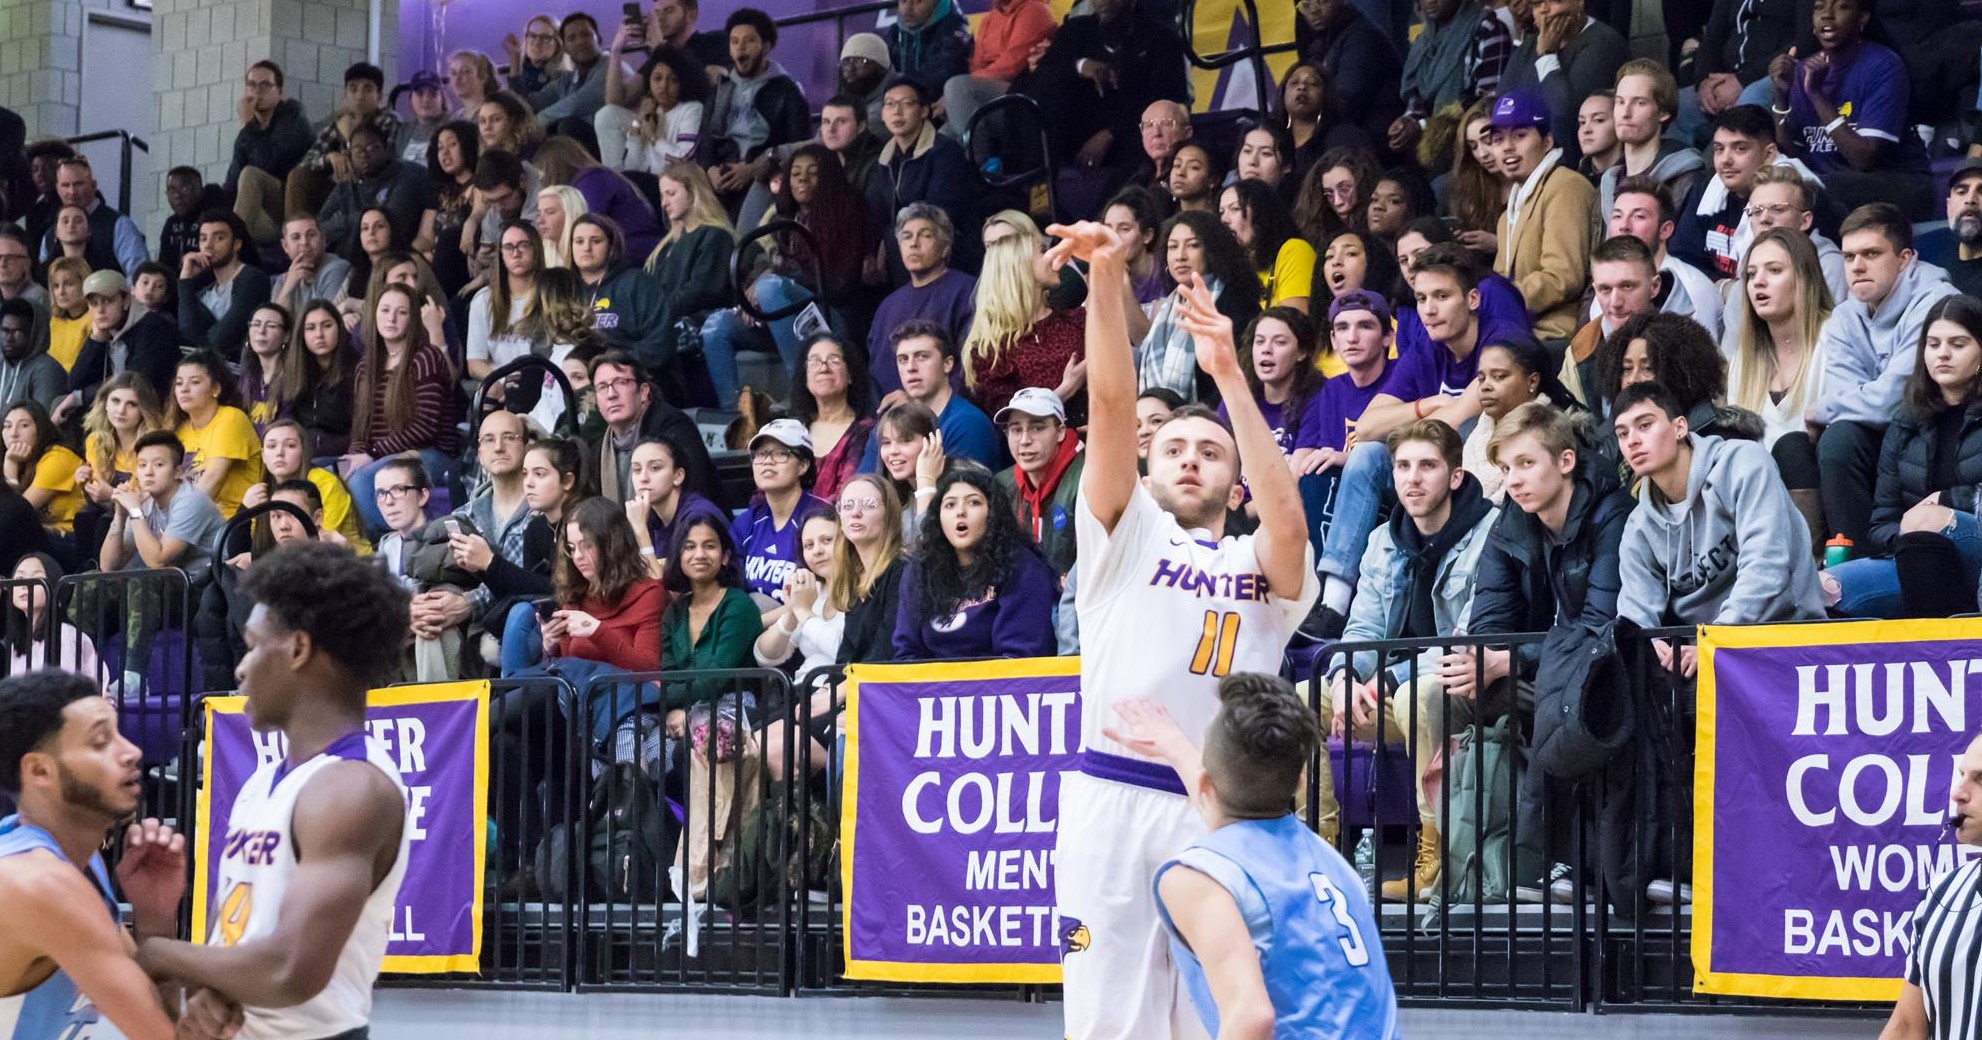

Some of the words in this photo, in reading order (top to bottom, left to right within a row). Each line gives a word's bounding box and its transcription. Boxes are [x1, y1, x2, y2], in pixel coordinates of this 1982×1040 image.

[1150, 559, 1270, 605] HUNTER
[1189, 609, 1241, 678] 11
[914, 691, 1087, 759] HUNT
[902, 770, 1062, 834] COLL
[1308, 871, 1370, 968] 3
